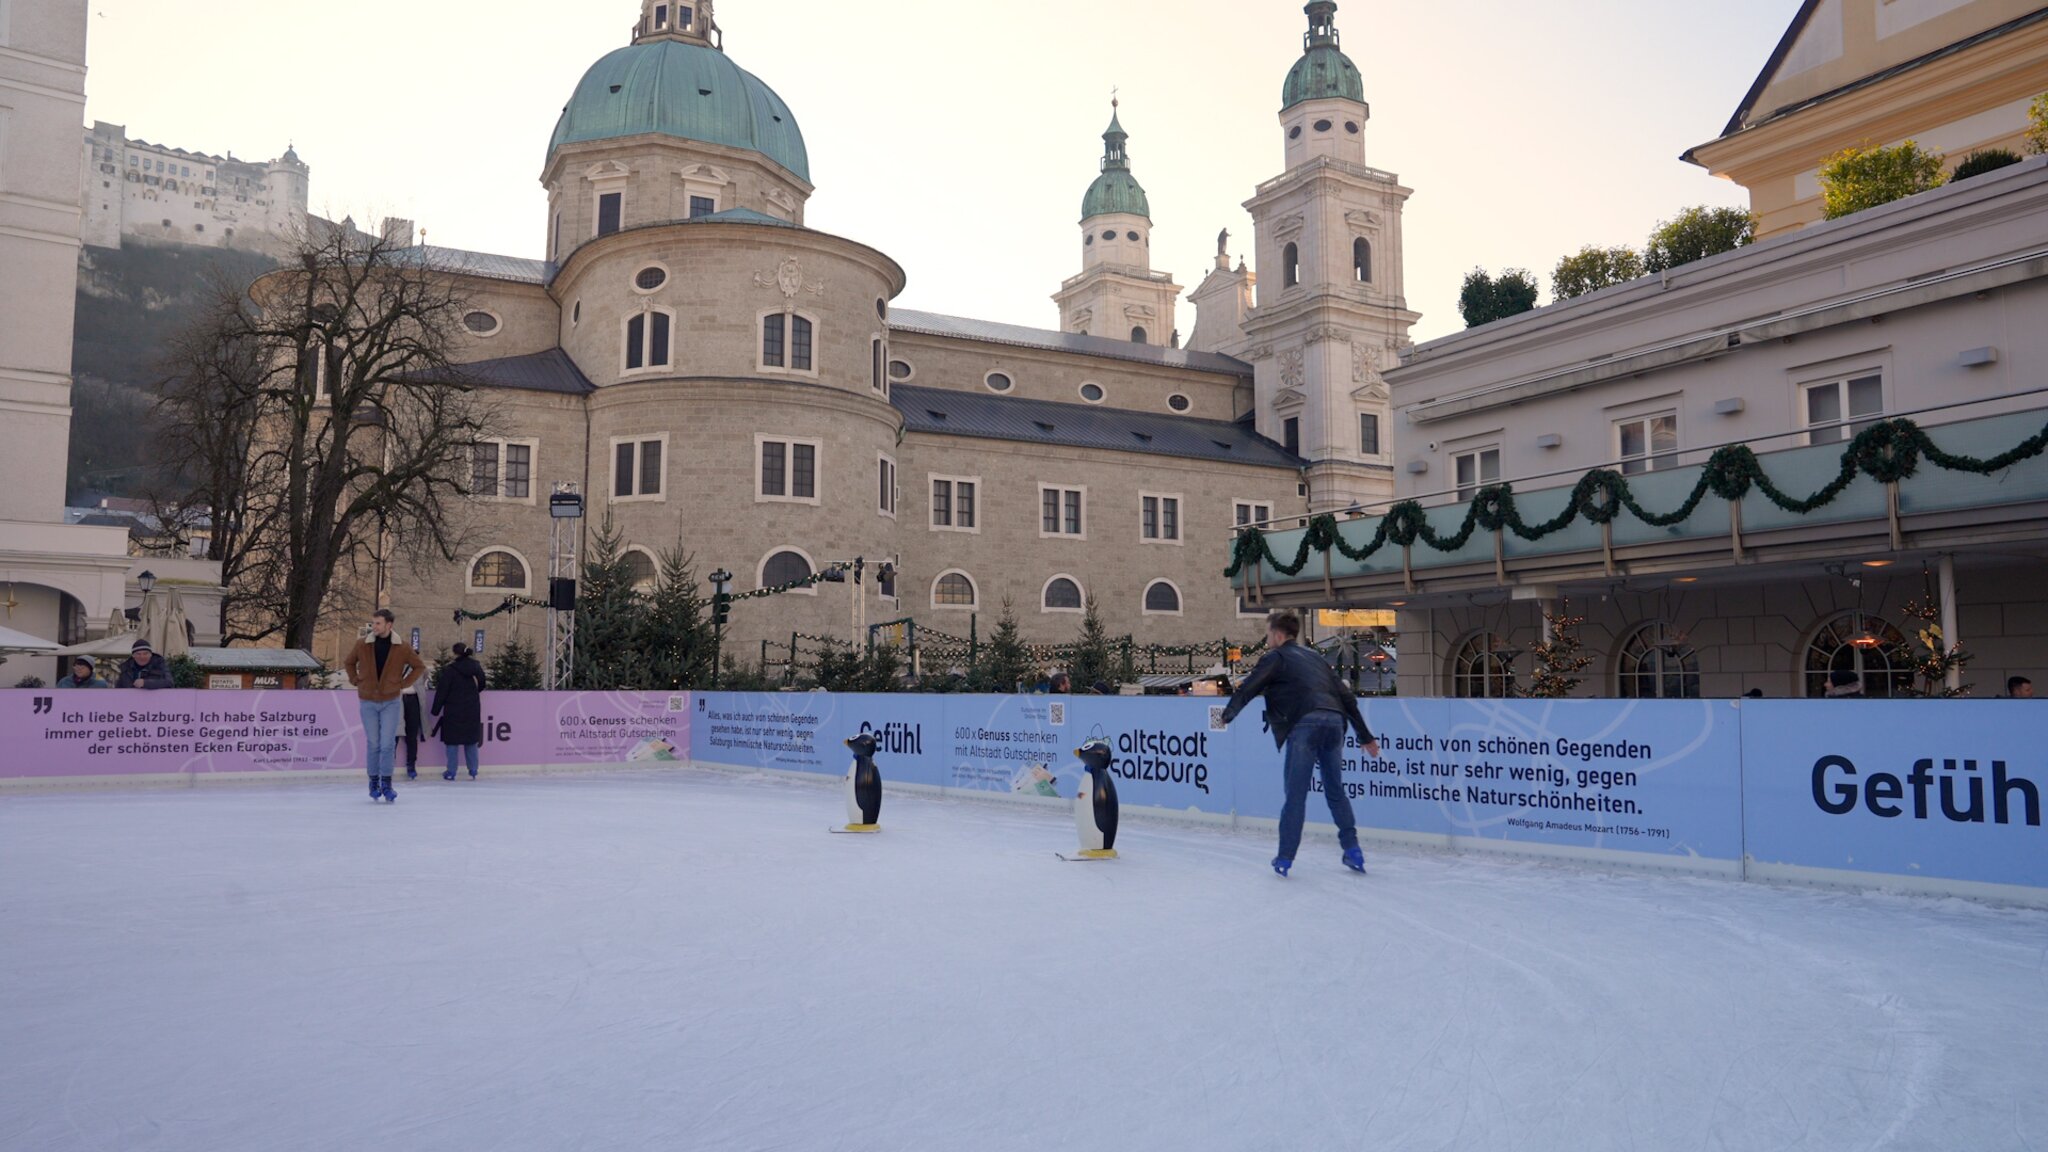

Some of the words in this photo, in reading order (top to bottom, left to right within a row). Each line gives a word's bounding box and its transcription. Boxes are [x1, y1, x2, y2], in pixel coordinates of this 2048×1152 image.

[62, 711, 84, 723] Ich
[88, 711, 124, 723] liebe
[129, 710, 195, 725] Salzburg.
[200, 711, 220, 723] Ich
[224, 711, 255, 722] habe
[260, 711, 316, 724] Salzburg
[560, 716, 579, 727] 600
[581, 718, 587, 726] x
[589, 716, 627, 726] Genuss
[630, 715, 677, 725] schenken
[708, 711, 722, 721] Alles,
[722, 712, 733, 720] was
[733, 711, 741, 720] ich
[742, 712, 754, 721] auch
[755, 714, 766, 722] von
[767, 713, 789, 723] schönen
[790, 713, 818, 726] Gegenden
[45, 728, 93, 740] immer
[98, 727, 152, 741] geliebt.
[157, 727, 195, 738] Diese
[199, 726, 249, 740] Gegend
[253, 726, 279, 737] hier
[282, 726, 299, 737] ist
[303, 726, 329, 737] eine
[560, 730, 576, 740] mit
[578, 729, 617, 739] Altstadt
[619, 728, 676, 738] Gutscheinen
[710, 725, 730, 735] gesehen
[744, 726, 752, 735] ist
[752, 727, 761, 735] nur
[763, 727, 775, 736] sehr
[796, 729, 814, 741] gegen
[954, 726, 970, 740] 600
[971, 731, 977, 740] x
[977, 727, 1011, 742] Genuss
[1012, 729, 1058, 745] schenken
[88, 743, 113, 755] der
[117, 742, 189, 754] schönsten
[194, 741, 233, 753] Ecken
[237, 741, 292, 754] Europas.
[709, 736, 732, 748] Salzburgs
[733, 738, 762, 749] himmlische
[763, 741, 815, 754] Naturschönheiten.
[1118, 728, 1208, 758] altstadt
[1395, 734, 1433, 751] auch
[1440, 738, 1471, 753] von
[1478, 735, 1549, 756] schönen
[1556, 737, 1652, 762] Gegenden
[955, 745, 968, 757] mit
[969, 745, 1002, 759] Altstadt
[1003, 746, 1058, 762] Gutscheinen
[1110, 755, 1210, 795] salzburg
[1361, 756, 1401, 777] habe,
[1406, 758, 1426, 776] ist
[1430, 762, 1459, 777] nur
[1464, 761, 1504, 779] sehr
[1509, 764, 1570, 787] wenig,
[1577, 769, 1637, 790] gegen
[1370, 779, 1461, 802] himmlische
[1467, 785, 1643, 815] Naturschönheiten.
[1811, 753, 2041, 827] Gefüh
[1507, 817, 1543, 830] Wolfgang
[1545, 820, 1583, 832] Amadeus
[1584, 823, 1614, 834] Mozart
